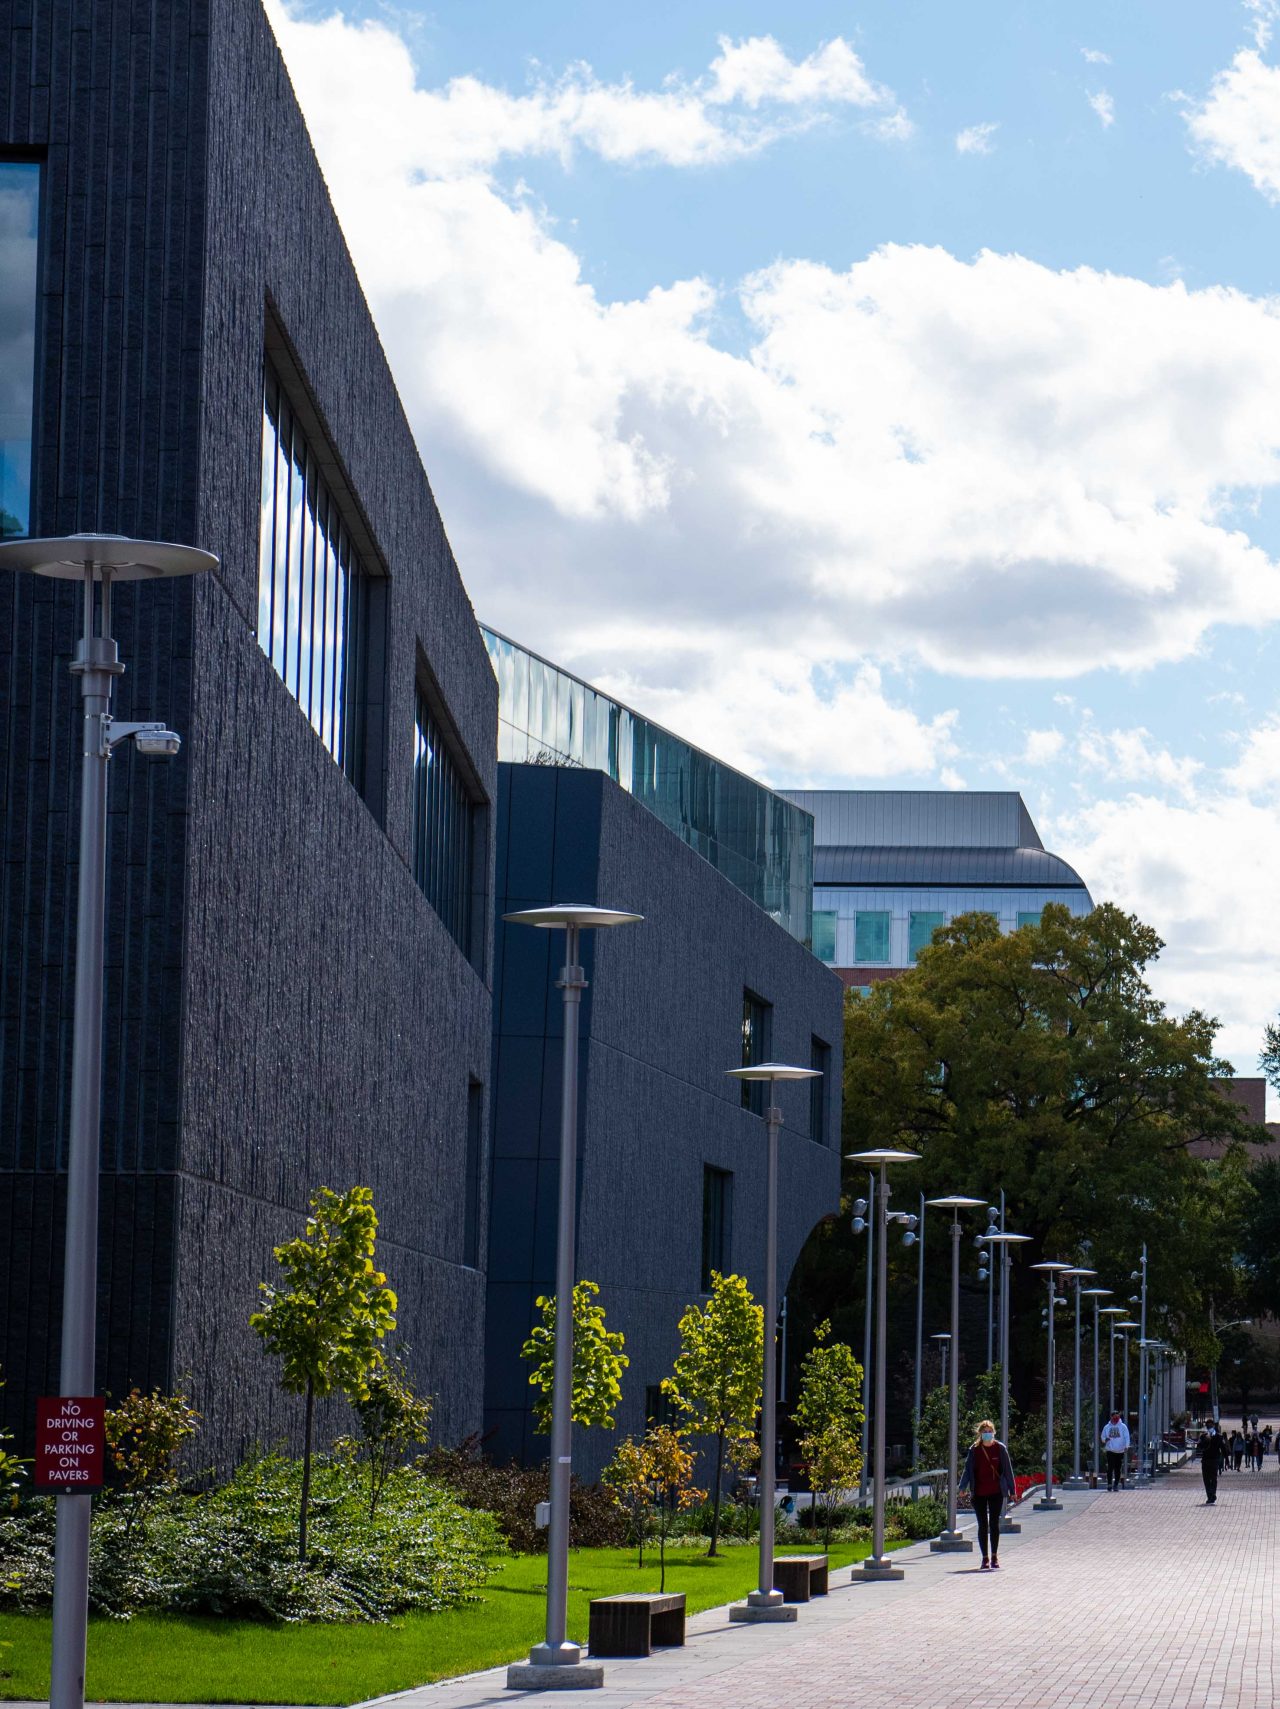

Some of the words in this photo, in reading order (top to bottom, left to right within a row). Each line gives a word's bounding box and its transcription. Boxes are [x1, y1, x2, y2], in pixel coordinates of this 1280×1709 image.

[61, 1405, 81, 1416] NO
[46, 1418, 95, 1429] DRIVING
[61, 1431, 78, 1442] OR
[44, 1444, 95, 1455] PARKING
[59, 1457, 79, 1468] ON
[48, 1470, 89, 1481] PAVERS
